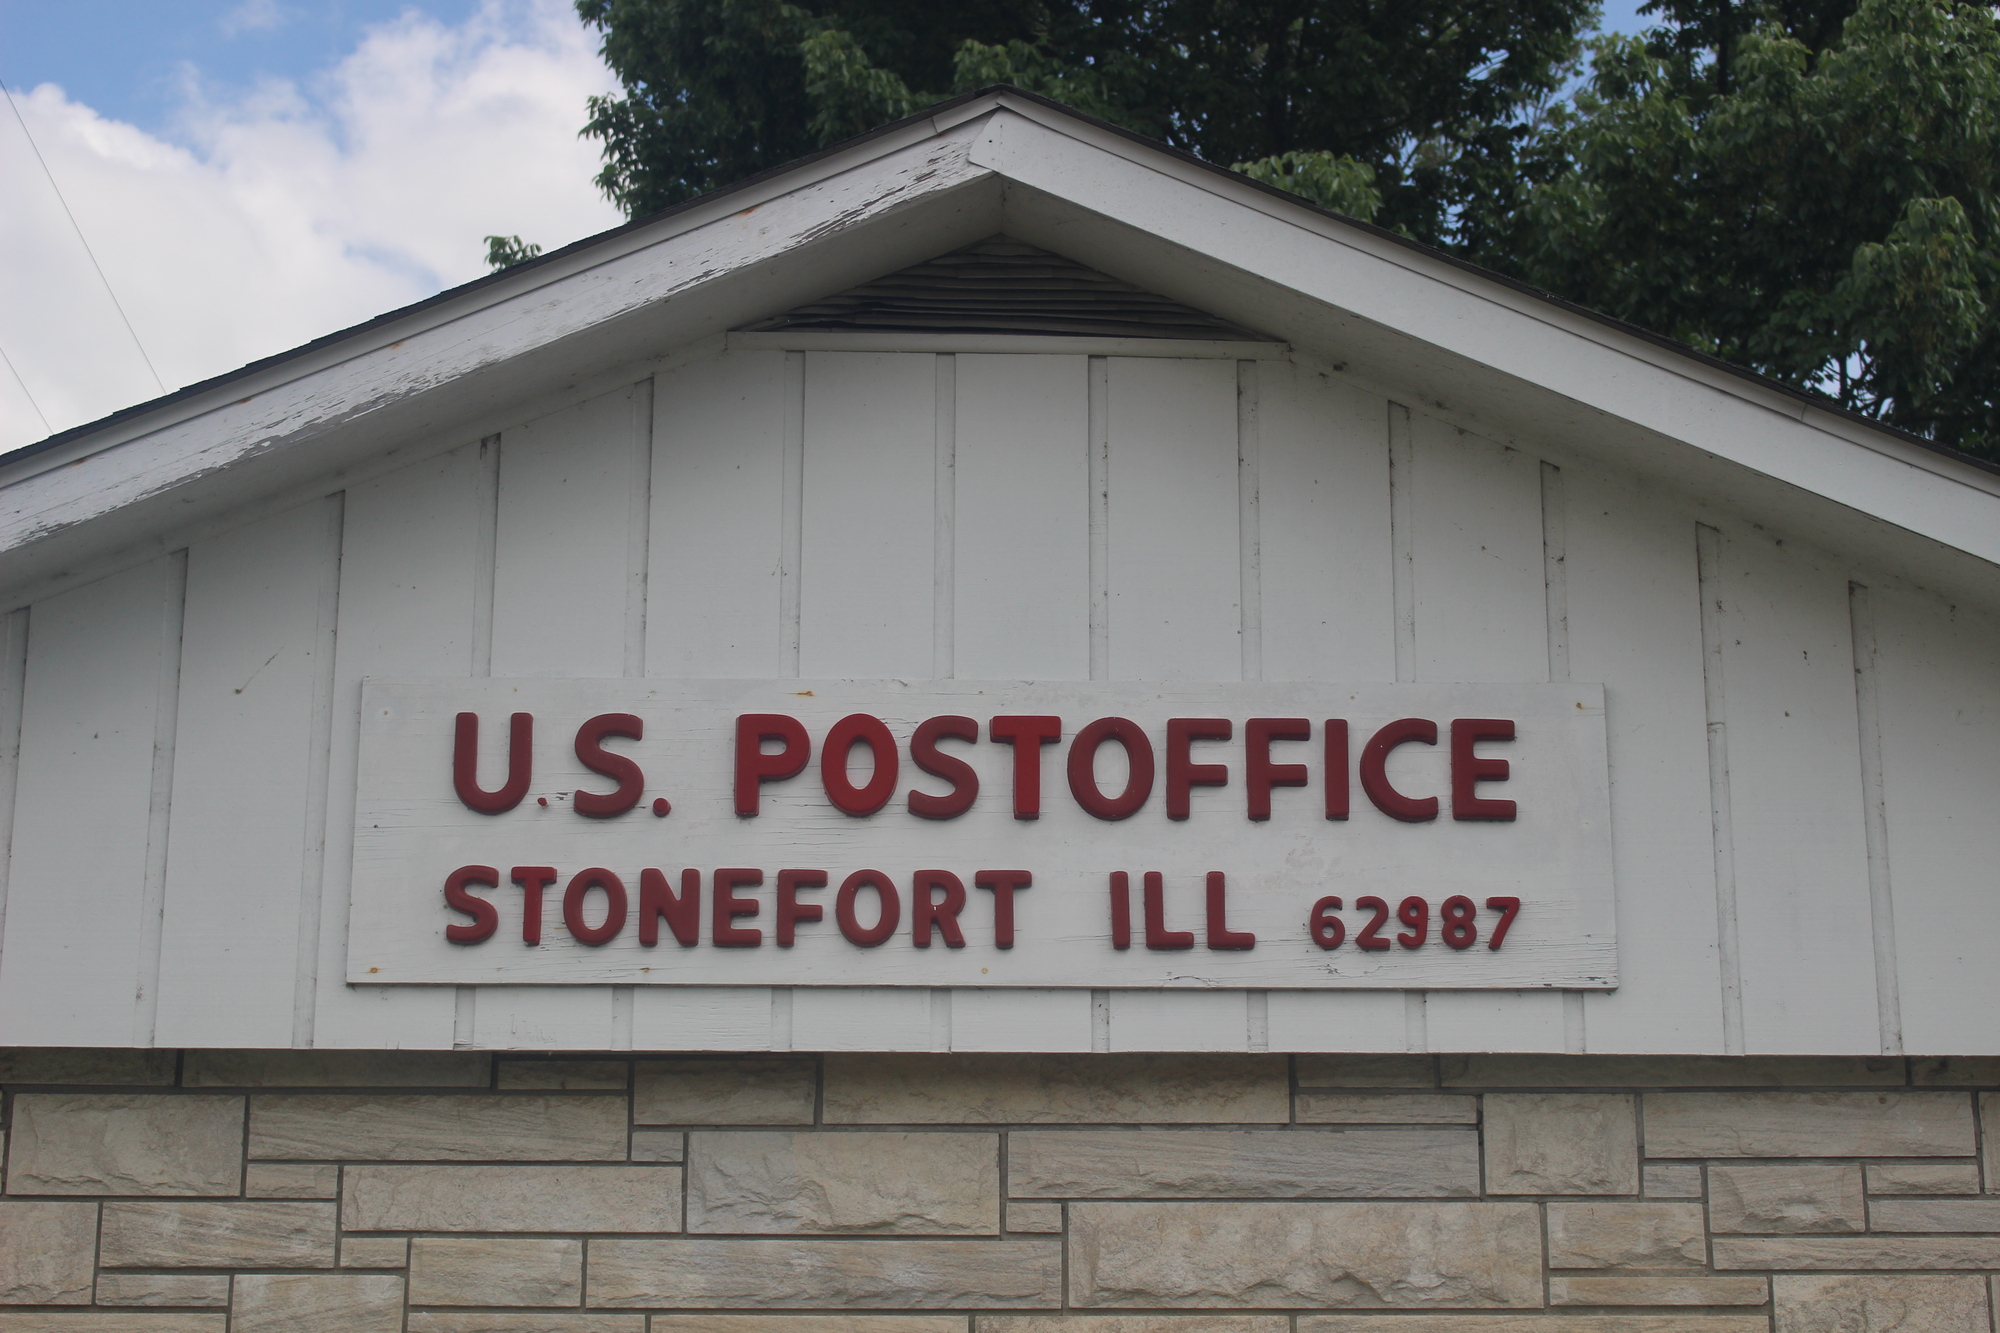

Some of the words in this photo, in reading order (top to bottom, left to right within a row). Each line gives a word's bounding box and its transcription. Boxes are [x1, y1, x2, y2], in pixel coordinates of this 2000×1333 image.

[454, 712, 672, 817] U.S.
[444, 864, 1034, 949] STONEFORT
[1109, 869, 1257, 949] ILL
[1309, 894, 1523, 951] 62987
